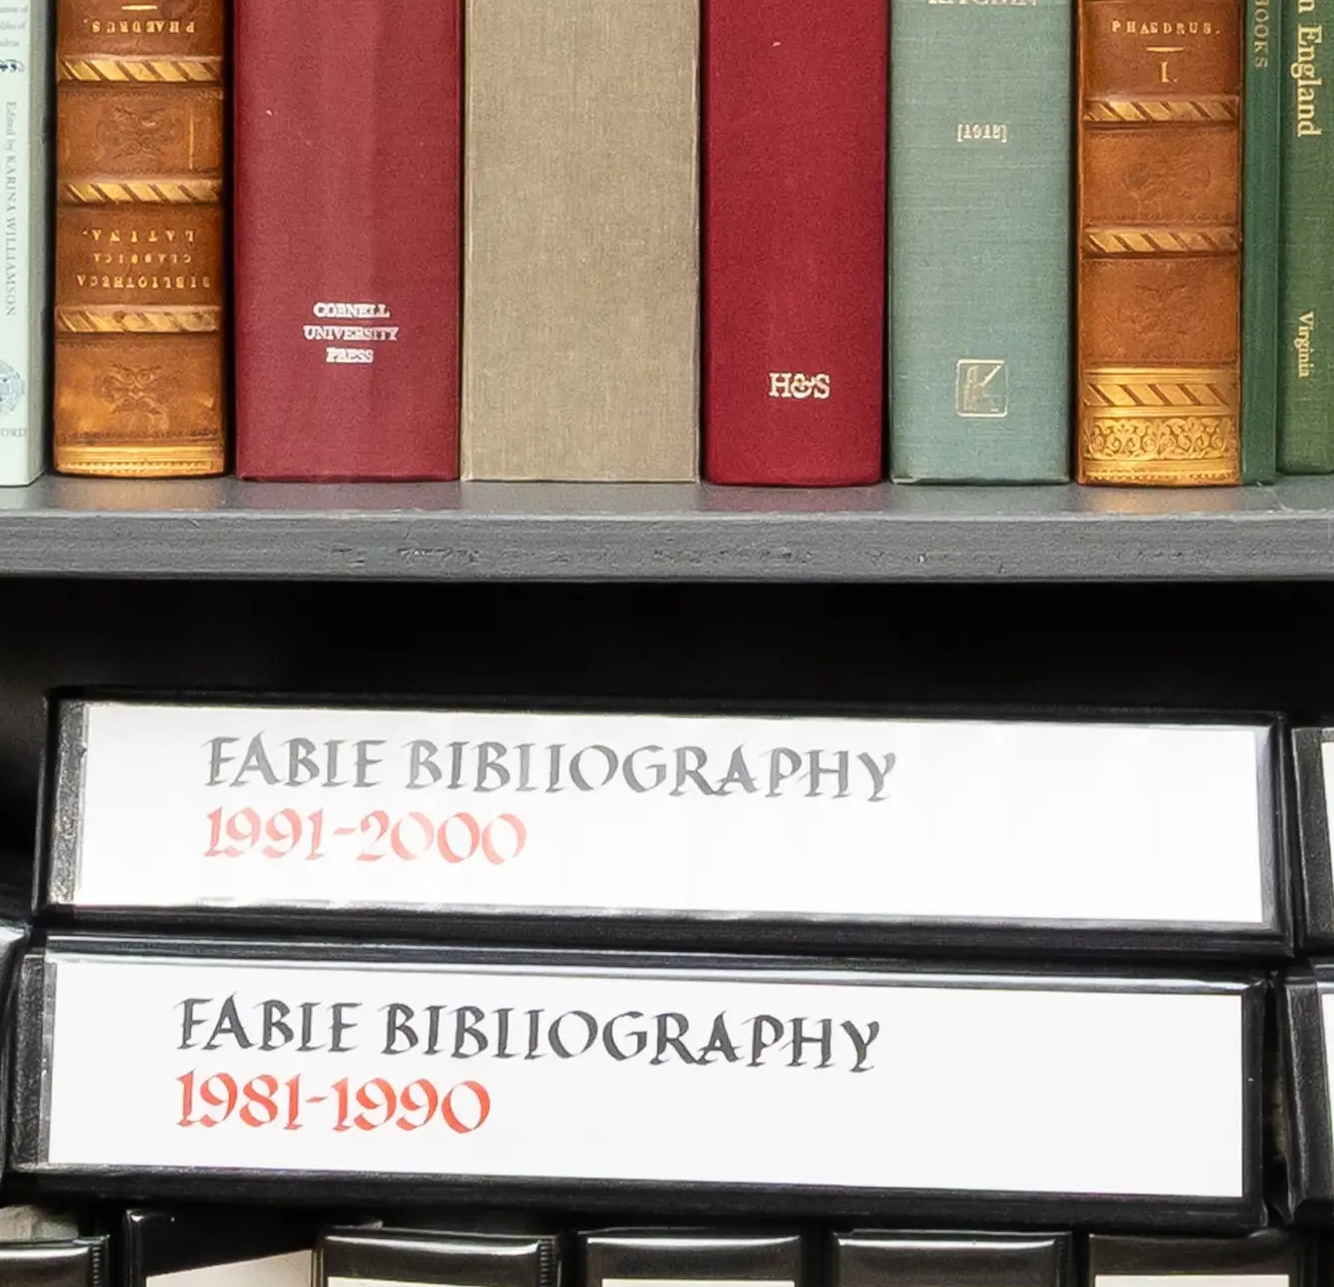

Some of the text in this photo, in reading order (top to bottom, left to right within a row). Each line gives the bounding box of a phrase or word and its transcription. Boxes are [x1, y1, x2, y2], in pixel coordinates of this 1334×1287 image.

[1291, 24, 1322, 137] England
[1294, 312, 1314, 377] Virginia
[769, 373, 830, 398] H&S
[206, 732, 895, 802] FABLE BIBLIOGRAPHY
[204, 807, 526, 865] 1991-2000
[178, 995, 879, 1073] FABLE BIBLIOGRAPHY
[177, 1071, 490, 1134] 1981-1990
